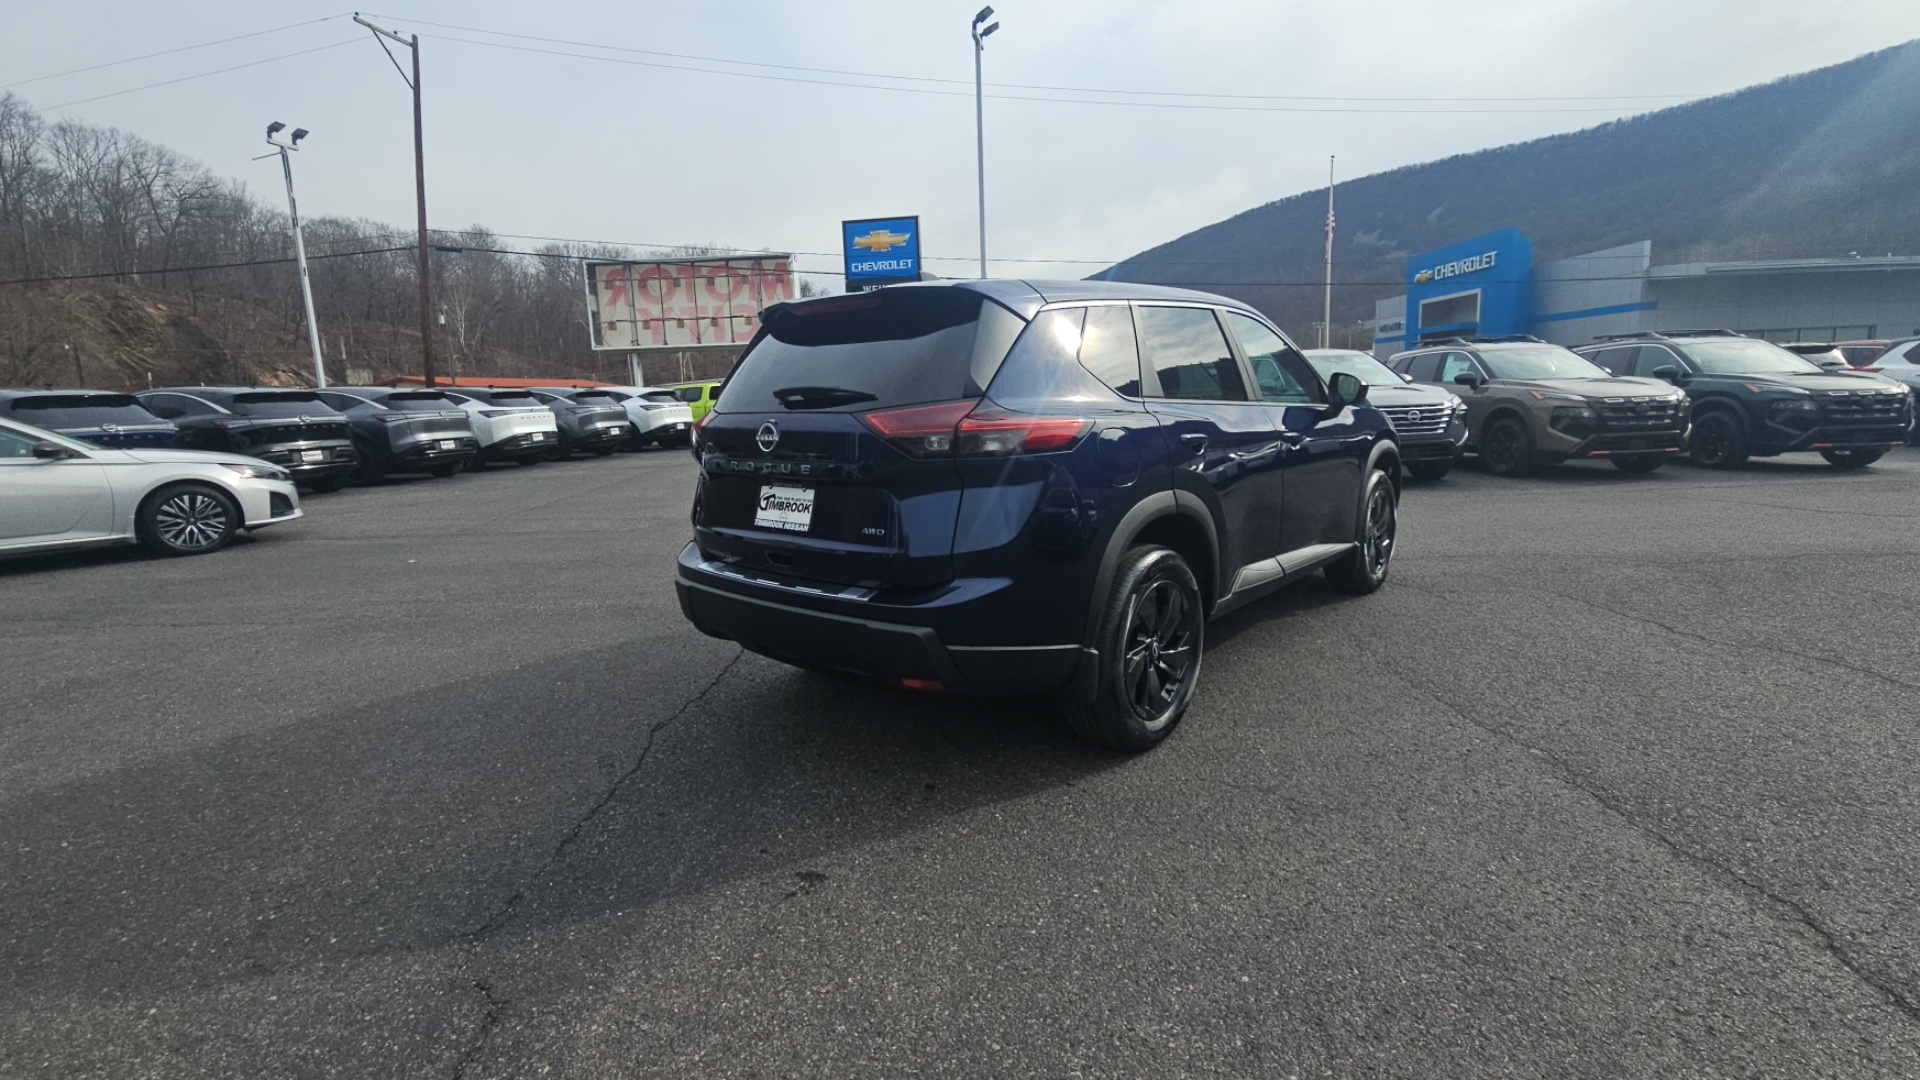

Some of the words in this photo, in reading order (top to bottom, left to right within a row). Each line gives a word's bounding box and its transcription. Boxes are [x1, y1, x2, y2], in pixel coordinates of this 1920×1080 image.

[851, 259, 913, 272] CHEVROLET
[1434, 250, 1498, 280] CHEVROLET
[730, 461, 811, 475] ROGUE
[760, 493, 812, 515] TIMBROOK
[783, 522, 809, 532] NISSAN
[861, 527, 885, 536] AWD
